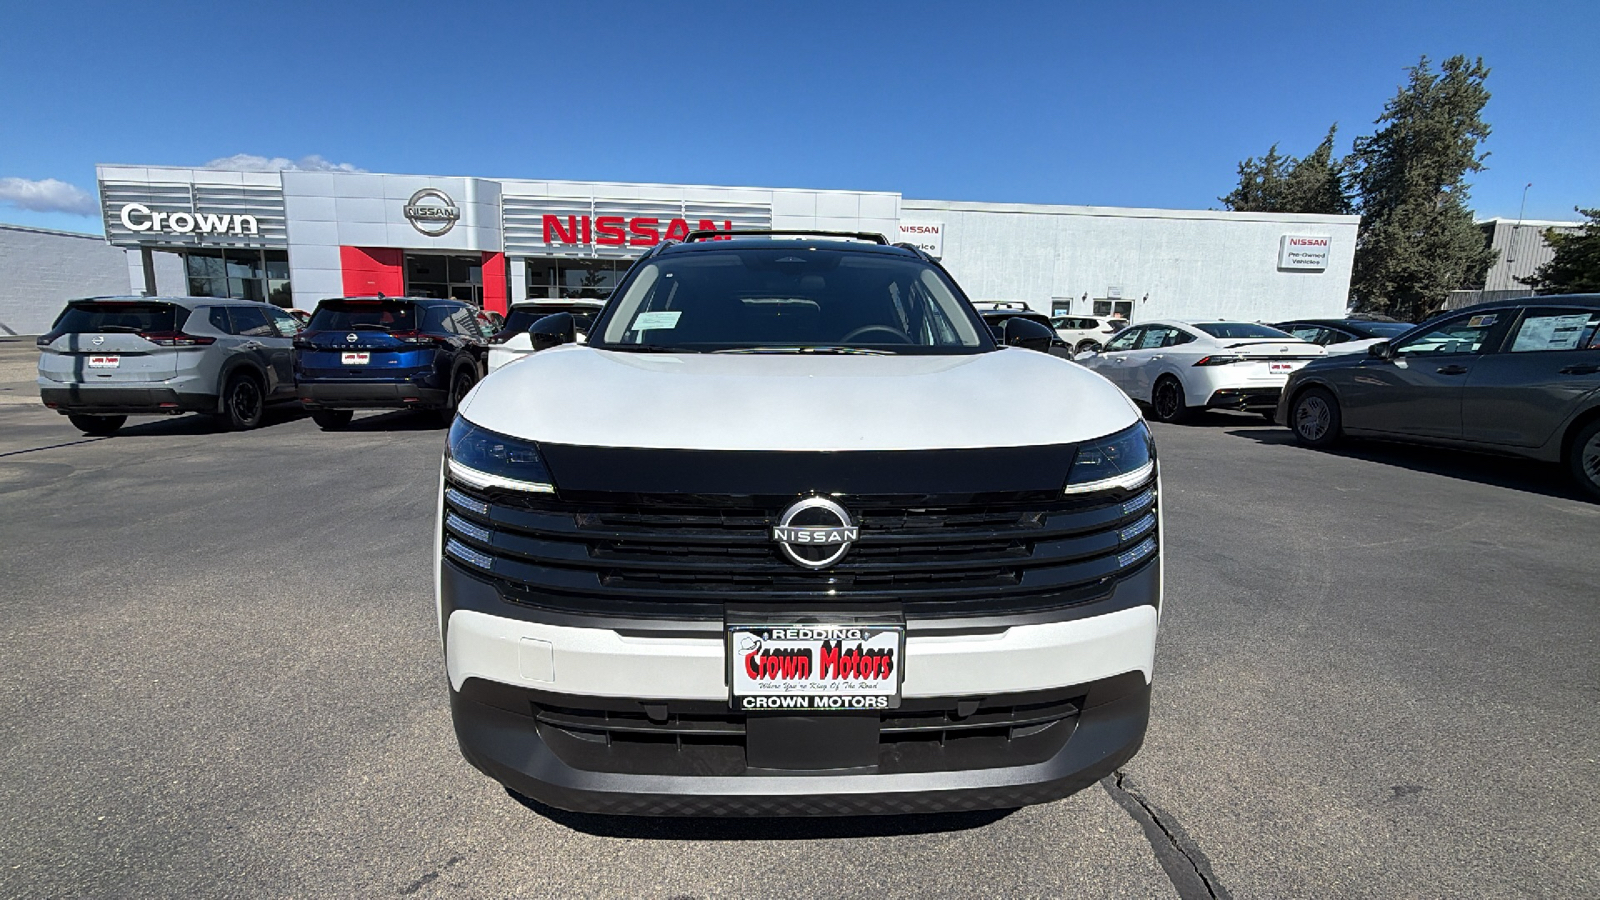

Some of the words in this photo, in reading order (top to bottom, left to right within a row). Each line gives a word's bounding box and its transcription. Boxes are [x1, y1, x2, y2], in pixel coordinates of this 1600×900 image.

[408, 207, 454, 216] NISSAN
[121, 203, 258, 234] Crown
[542, 214, 732, 246] NISSAN
[899, 225, 939, 234] NISSAN
[1289, 238, 1328, 246] NISSAN
[774, 529, 857, 542] NISSAN
[772, 629, 861, 640] REDDING
[744, 643, 812, 681] Crown
[819, 641, 894, 681] Motors
[809, 682, 827, 691] King
[829, 682, 841, 691] Of
[842, 681, 855, 689] The
[742, 696, 809, 708] CROWN
[814, 696, 888, 708] MOTORS
